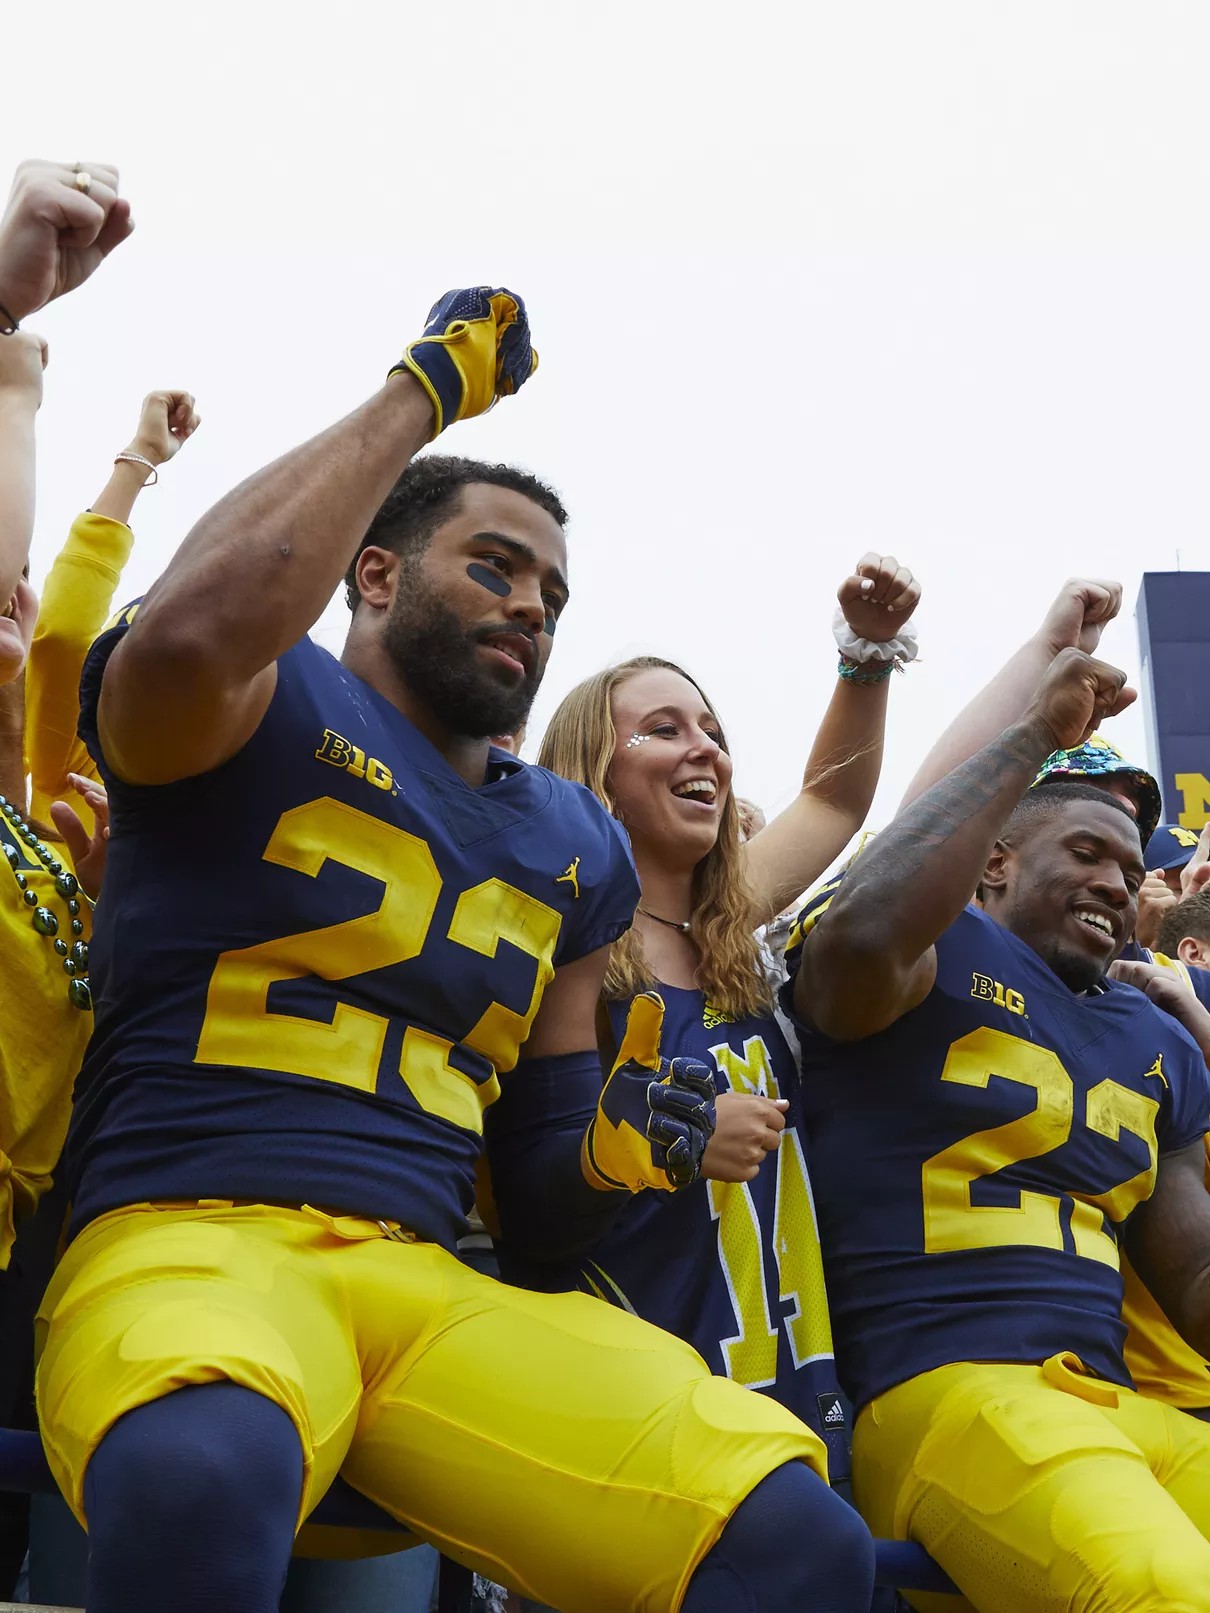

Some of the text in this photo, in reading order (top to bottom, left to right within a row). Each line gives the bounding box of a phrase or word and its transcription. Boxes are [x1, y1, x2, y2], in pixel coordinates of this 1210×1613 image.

[195, 796, 562, 1136] 23
[707, 1035, 781, 1100] M
[922, 1025, 1160, 1272] 22
